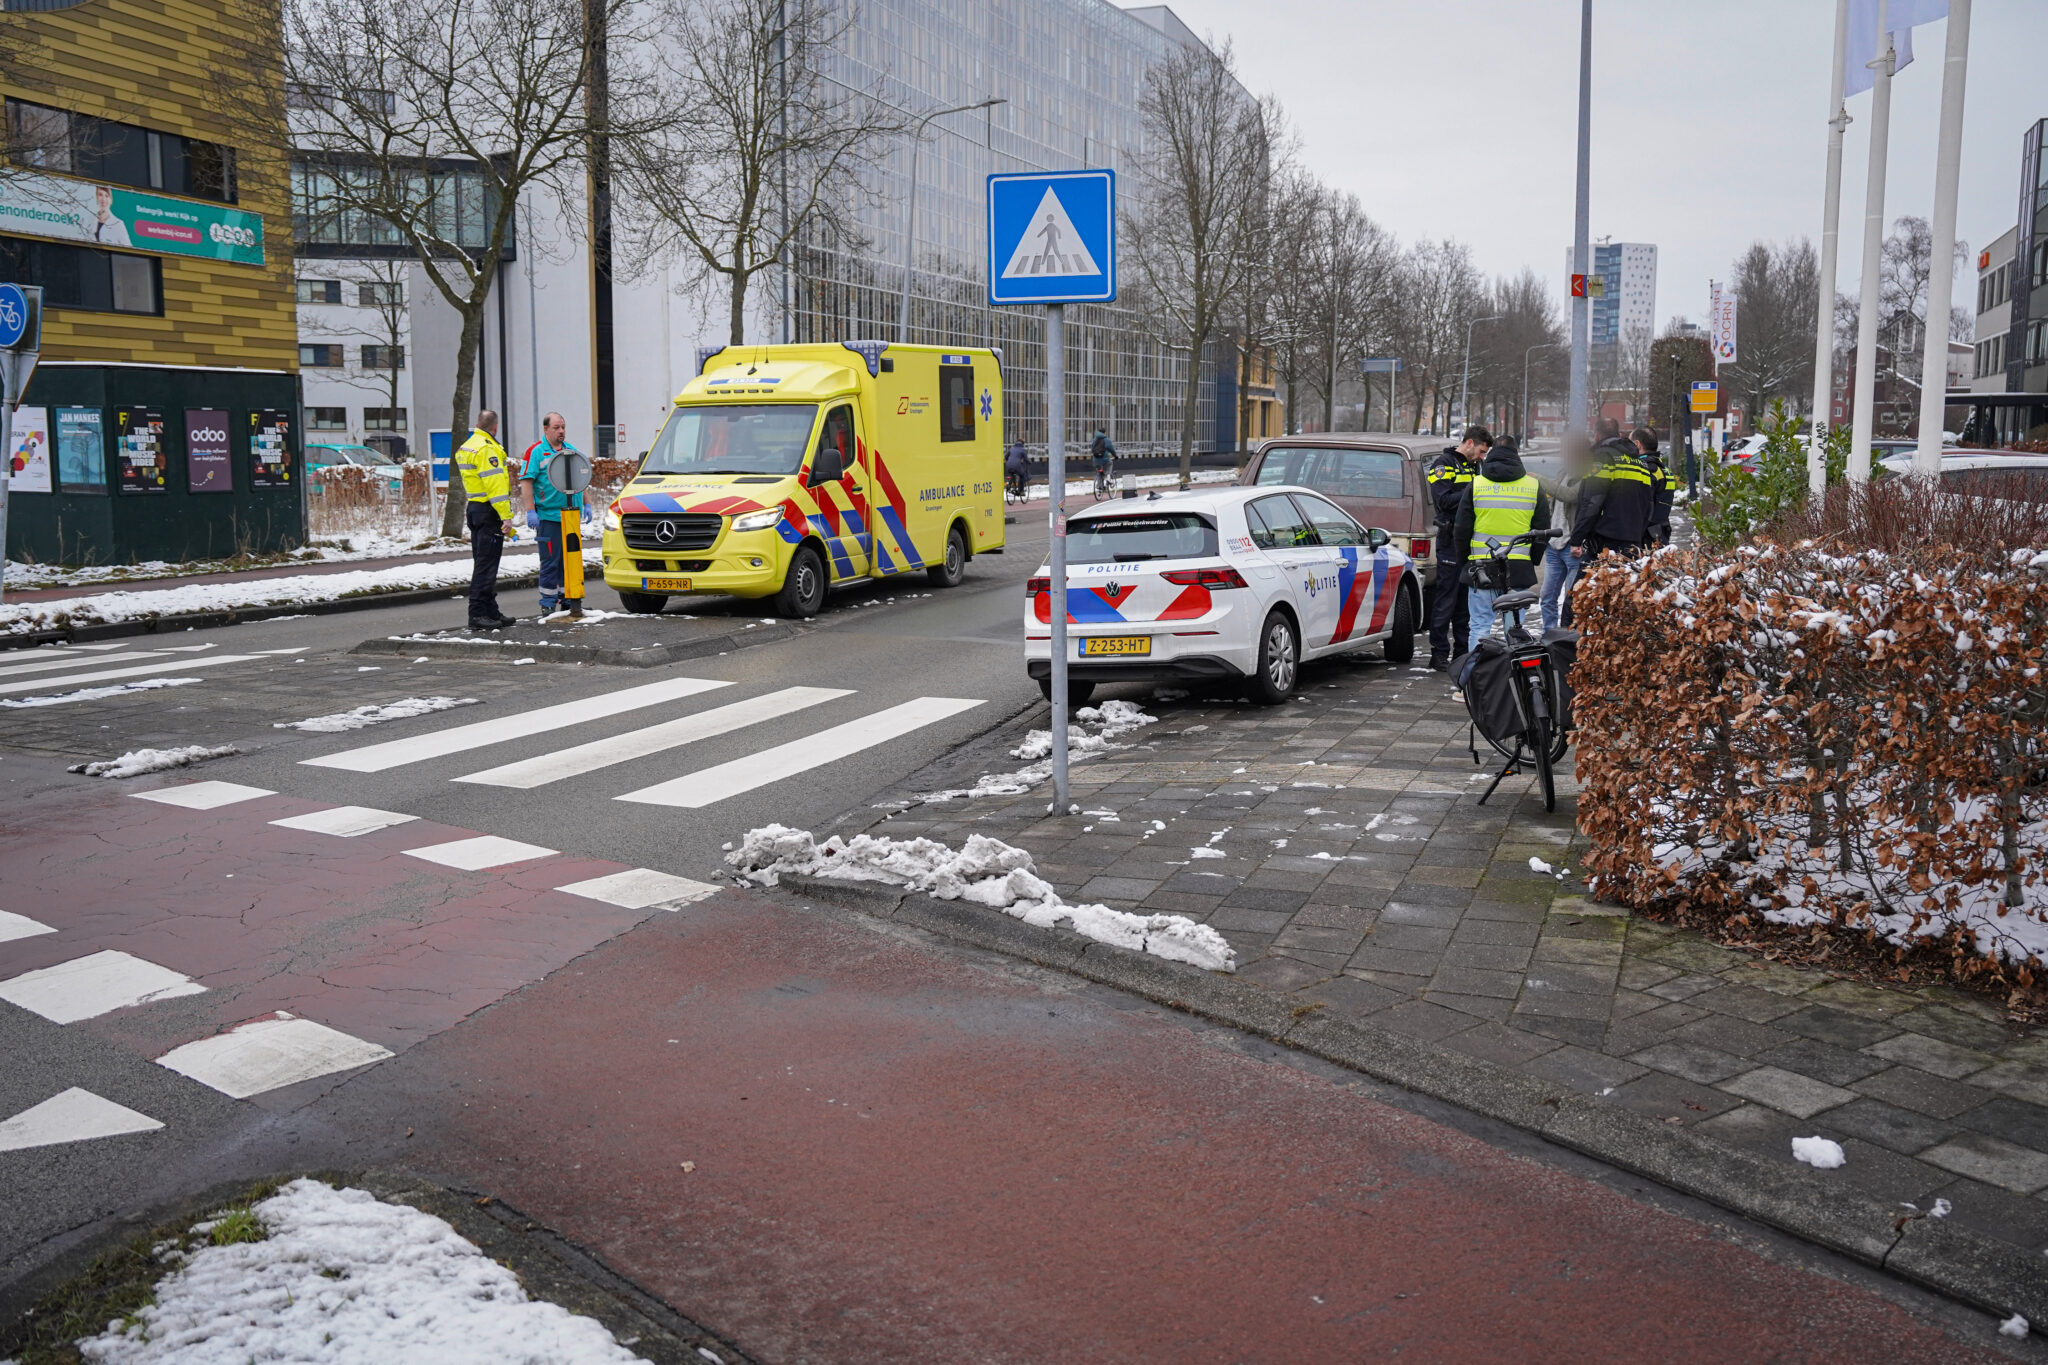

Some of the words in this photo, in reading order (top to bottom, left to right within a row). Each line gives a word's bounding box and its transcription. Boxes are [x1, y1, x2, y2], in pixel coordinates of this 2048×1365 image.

[1721, 301, 1732, 341] OCRN
[60, 413, 73, 423] JAN
[73, 413, 100, 423] MANKES
[119, 412, 128, 425] F
[251, 413, 259, 425] F
[133, 427, 149, 435] THE
[191, 426, 226, 441] odoo
[127, 435, 156, 443] WORLD
[258, 434, 282, 442] WORLD
[137, 443, 147, 451] OF
[266, 441, 274, 449] OF
[129, 451, 156, 459] MUSIC
[259, 448, 282, 456] MUSIC
[131, 459, 155, 467] VIDEO
[920, 485, 965, 502] AMBULANCE
[973, 482, 993, 495] 01-125
[1487, 483, 1524, 493] POLITIE
[1238, 537, 1252, 547] 112
[1088, 564, 1140, 573] POLITIE
[648, 579, 688, 589] P-659-NR
[1304, 575, 1337, 597] POLITIE
[1090, 639, 1144, 652] Z-253-HT
